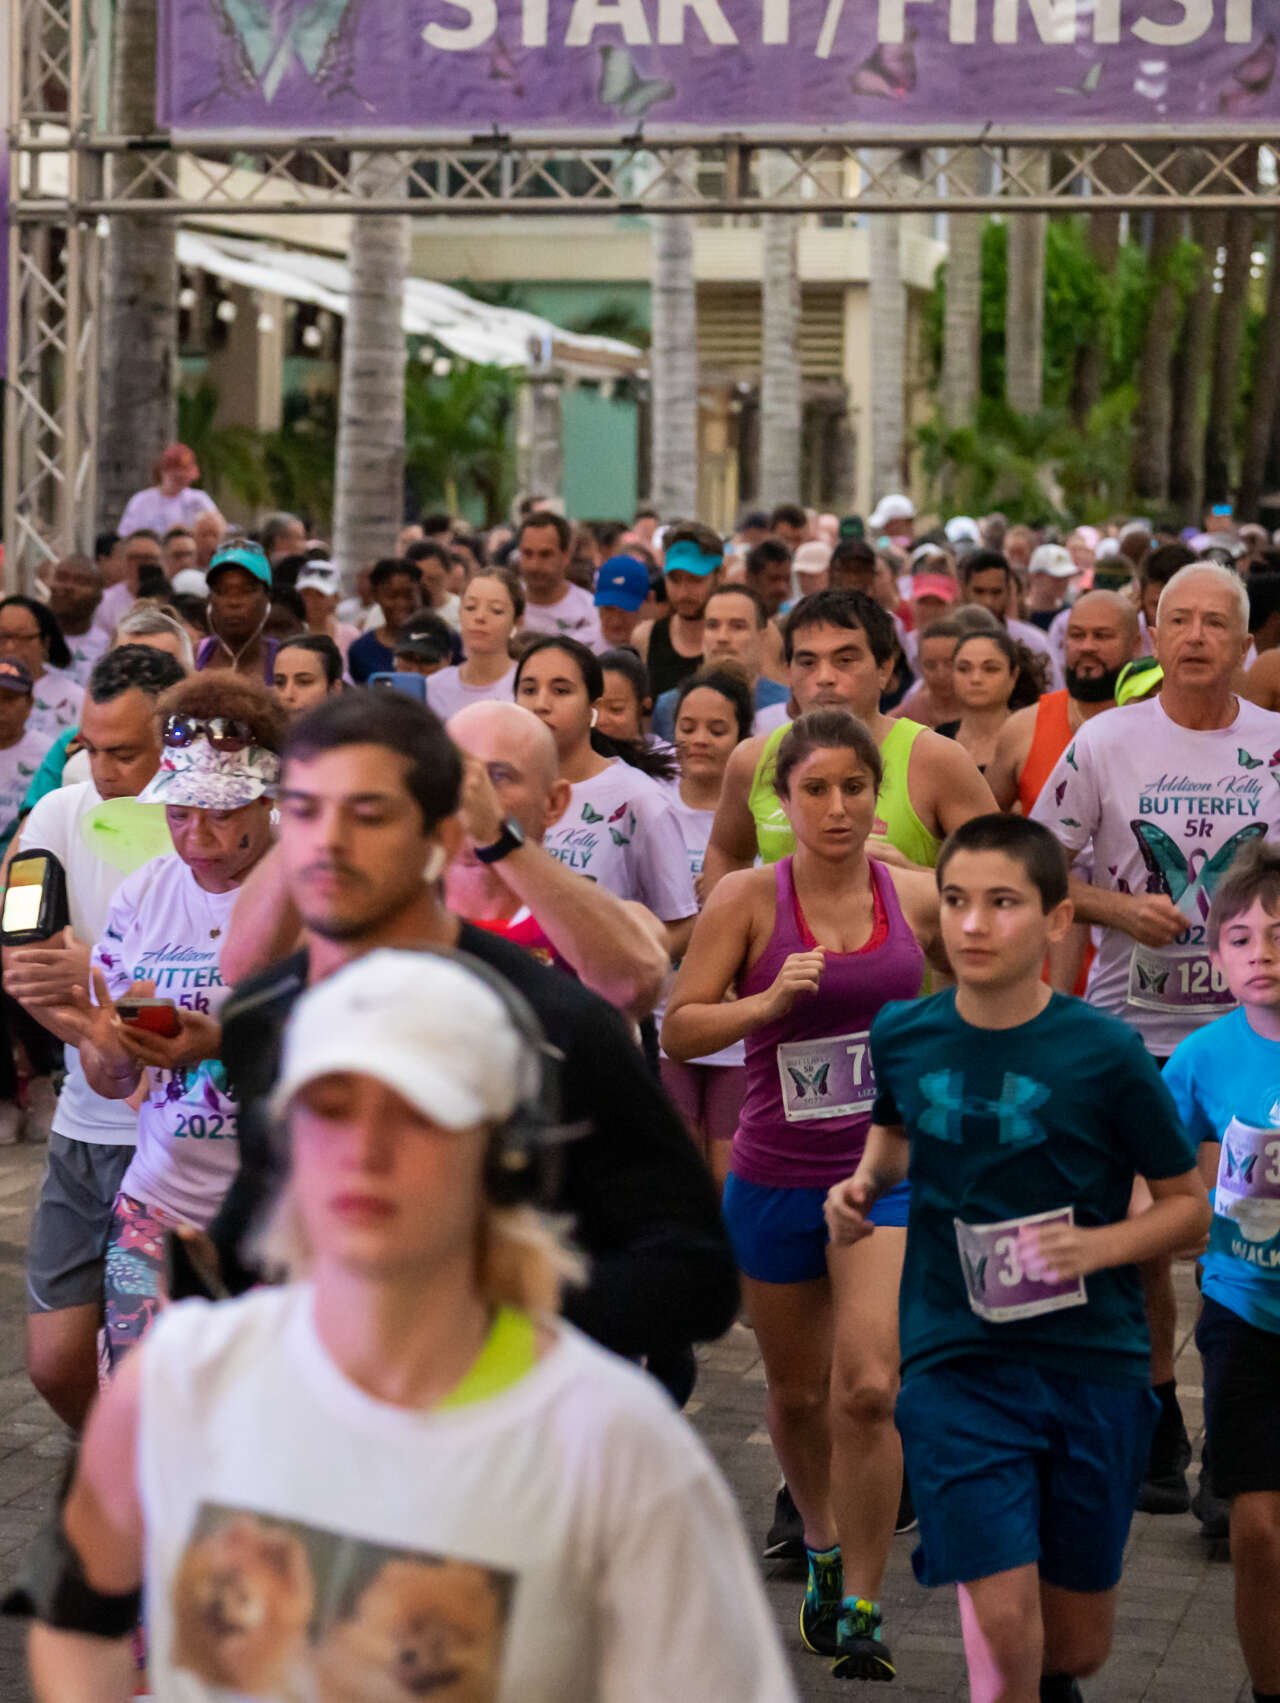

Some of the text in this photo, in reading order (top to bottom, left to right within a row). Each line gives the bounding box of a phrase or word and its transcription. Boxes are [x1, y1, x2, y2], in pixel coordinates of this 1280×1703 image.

[419, 0, 1253, 58] START/FINIS
[1138, 773, 1263, 800] Addison Kelly
[1139, 796, 1260, 816] BUTTERFLY
[1184, 818, 1214, 838] 5k
[137, 942, 216, 964] Addison
[133, 966, 223, 988] BUTTER
[174, 1114, 238, 1140] 2023
